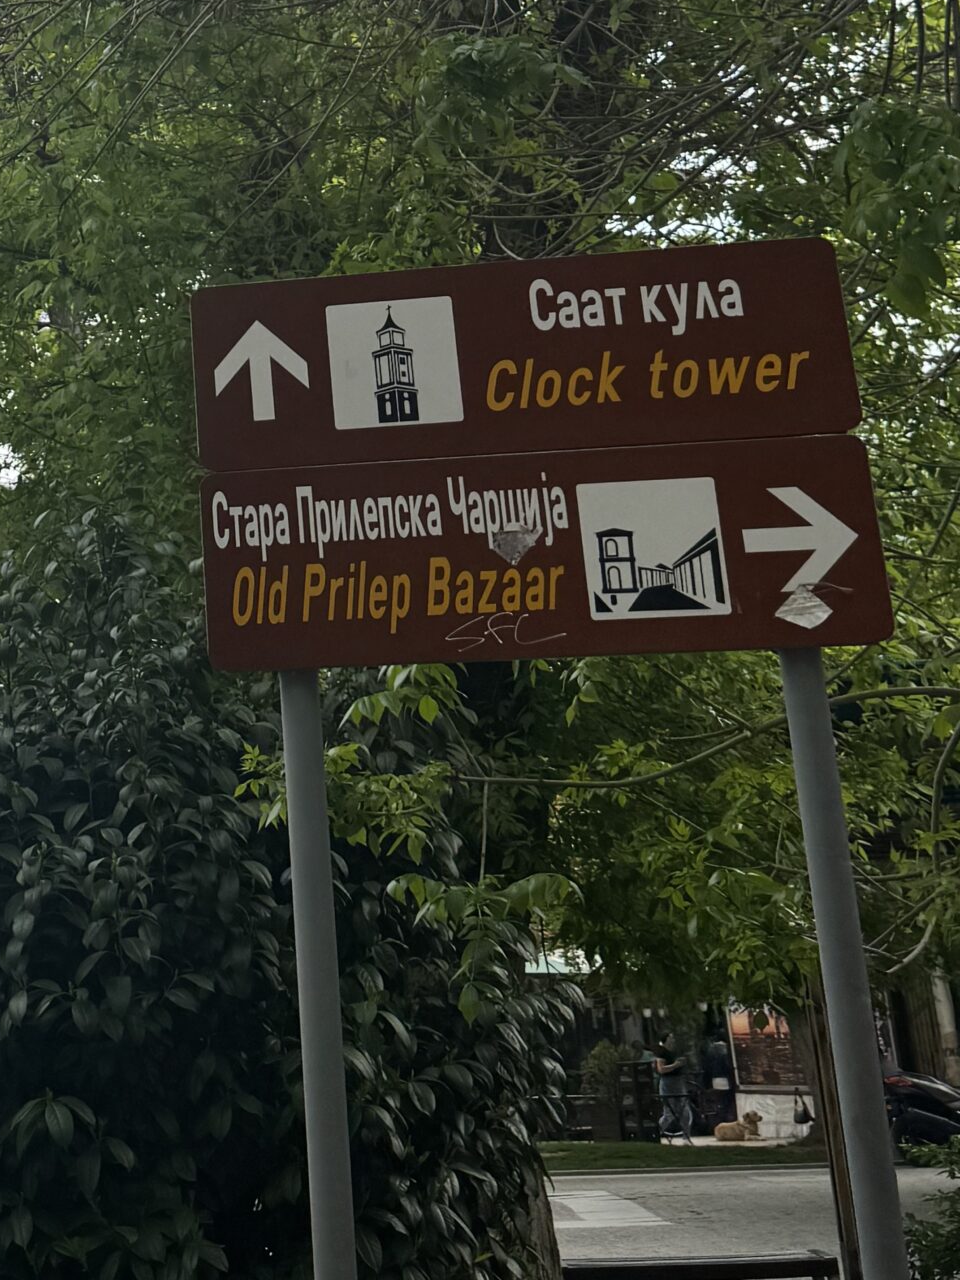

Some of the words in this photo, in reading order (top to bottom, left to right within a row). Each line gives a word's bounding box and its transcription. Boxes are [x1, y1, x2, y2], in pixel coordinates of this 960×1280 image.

[528, 278, 626, 331] Саат
[640, 278, 744, 336] кула
[486, 350, 626, 411] Clock
[649, 349, 809, 399] tower
[212, 490, 290, 562] Стара
[295, 485, 443, 559] Прилепска
[446, 472, 569, 549] Чаршија
[232, 565, 289, 627] Old
[303, 560, 411, 634] Prilep
[427, 556, 565, 616] Bazaar
